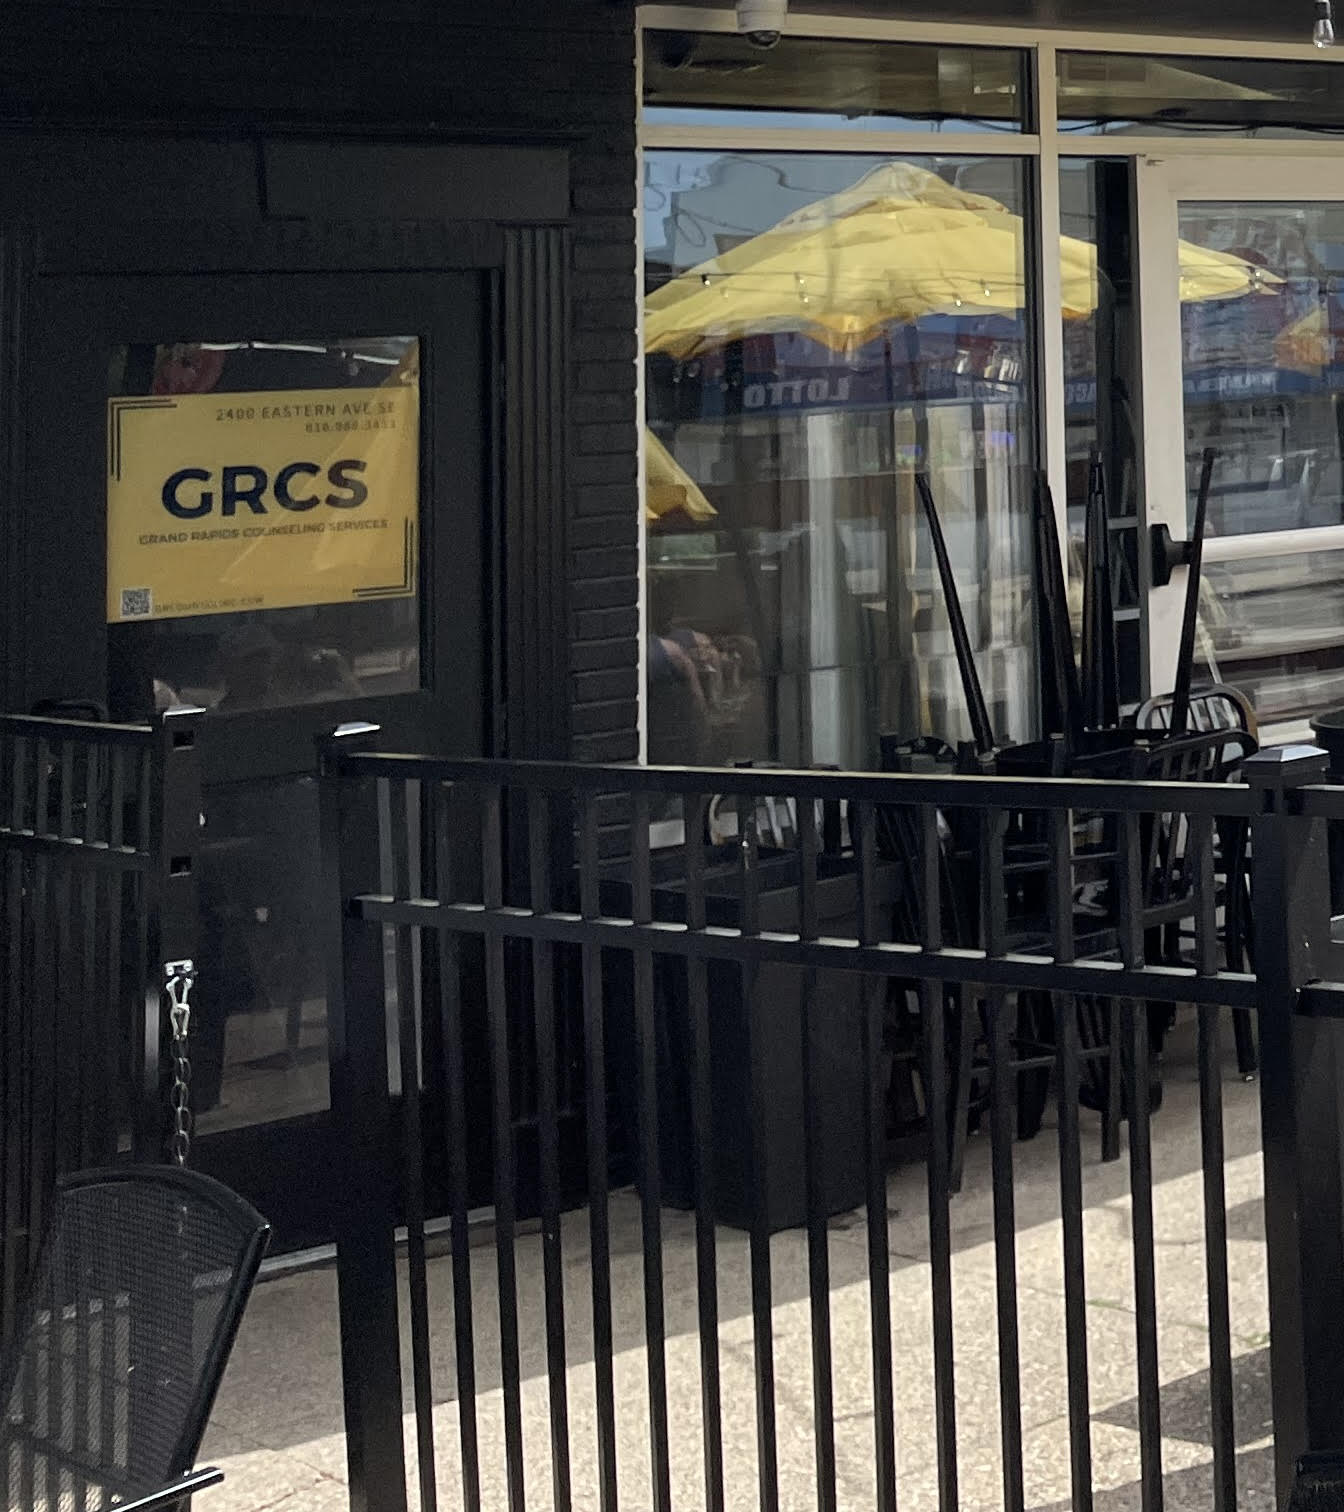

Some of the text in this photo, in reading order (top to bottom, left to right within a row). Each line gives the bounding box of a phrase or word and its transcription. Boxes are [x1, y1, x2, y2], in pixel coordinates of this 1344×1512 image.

[261, 403, 336, 419] EASTERN
[161, 459, 369, 519] GRCS
[139, 518, 389, 545] GRAND RAPIDS COUNSELING SERVICES
